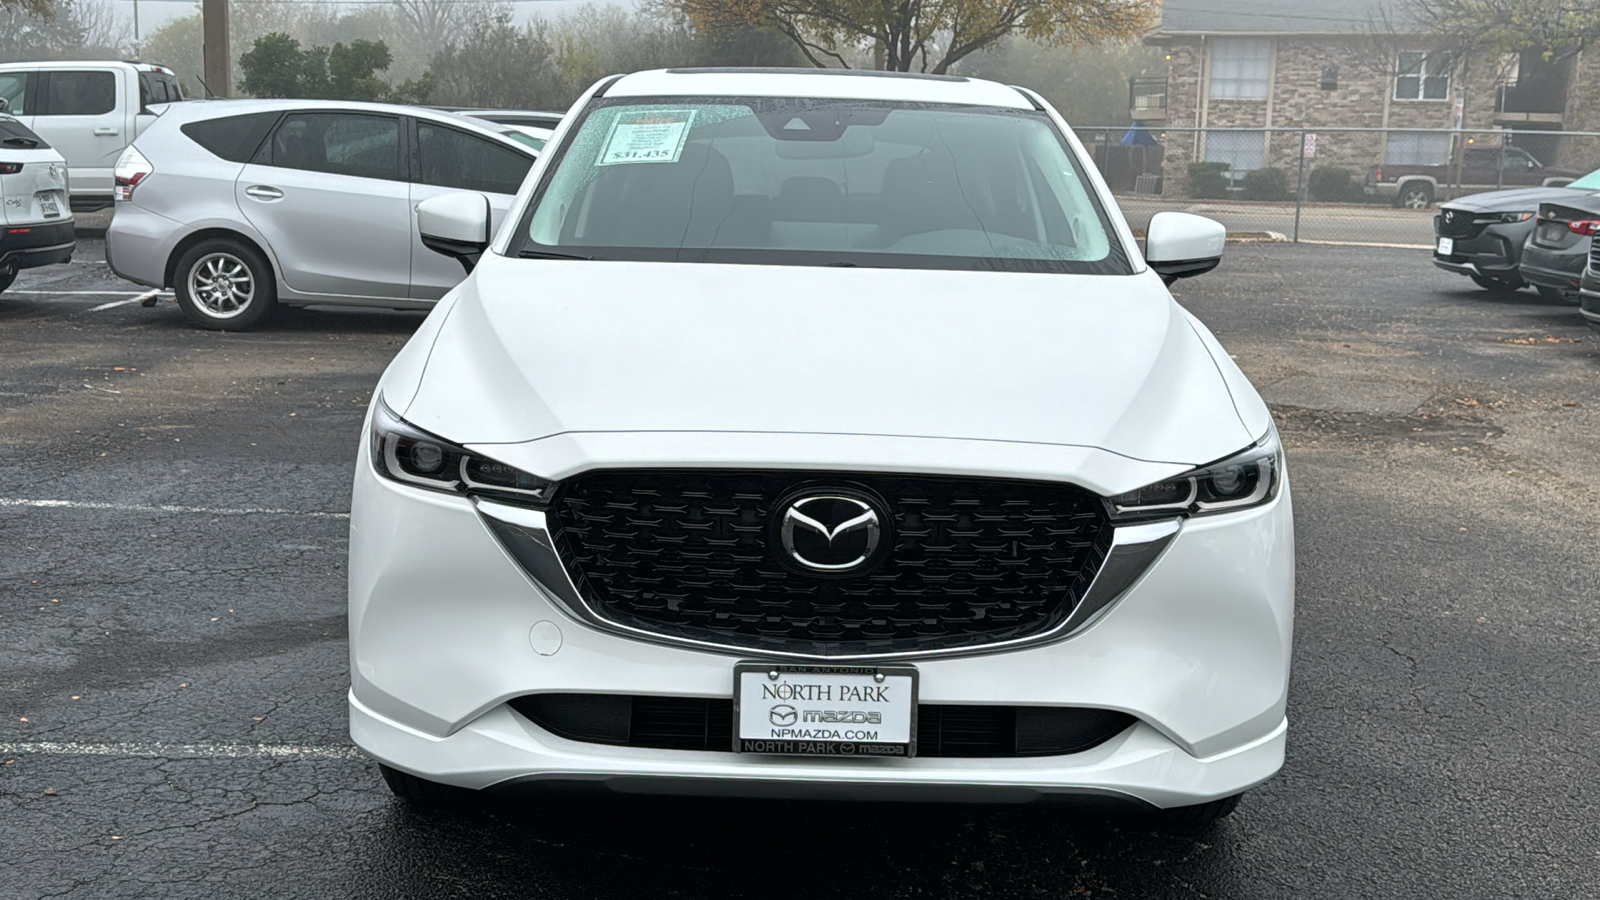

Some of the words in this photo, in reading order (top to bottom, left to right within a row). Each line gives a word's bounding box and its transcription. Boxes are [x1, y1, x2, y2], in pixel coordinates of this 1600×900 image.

[761, 682, 832, 701] NORTH
[839, 685, 890, 702] PARK
[771, 728, 878, 740] NPMAZDA.COM
[744, 741, 794, 752] NORTH
[799, 742, 836, 754] PARK
